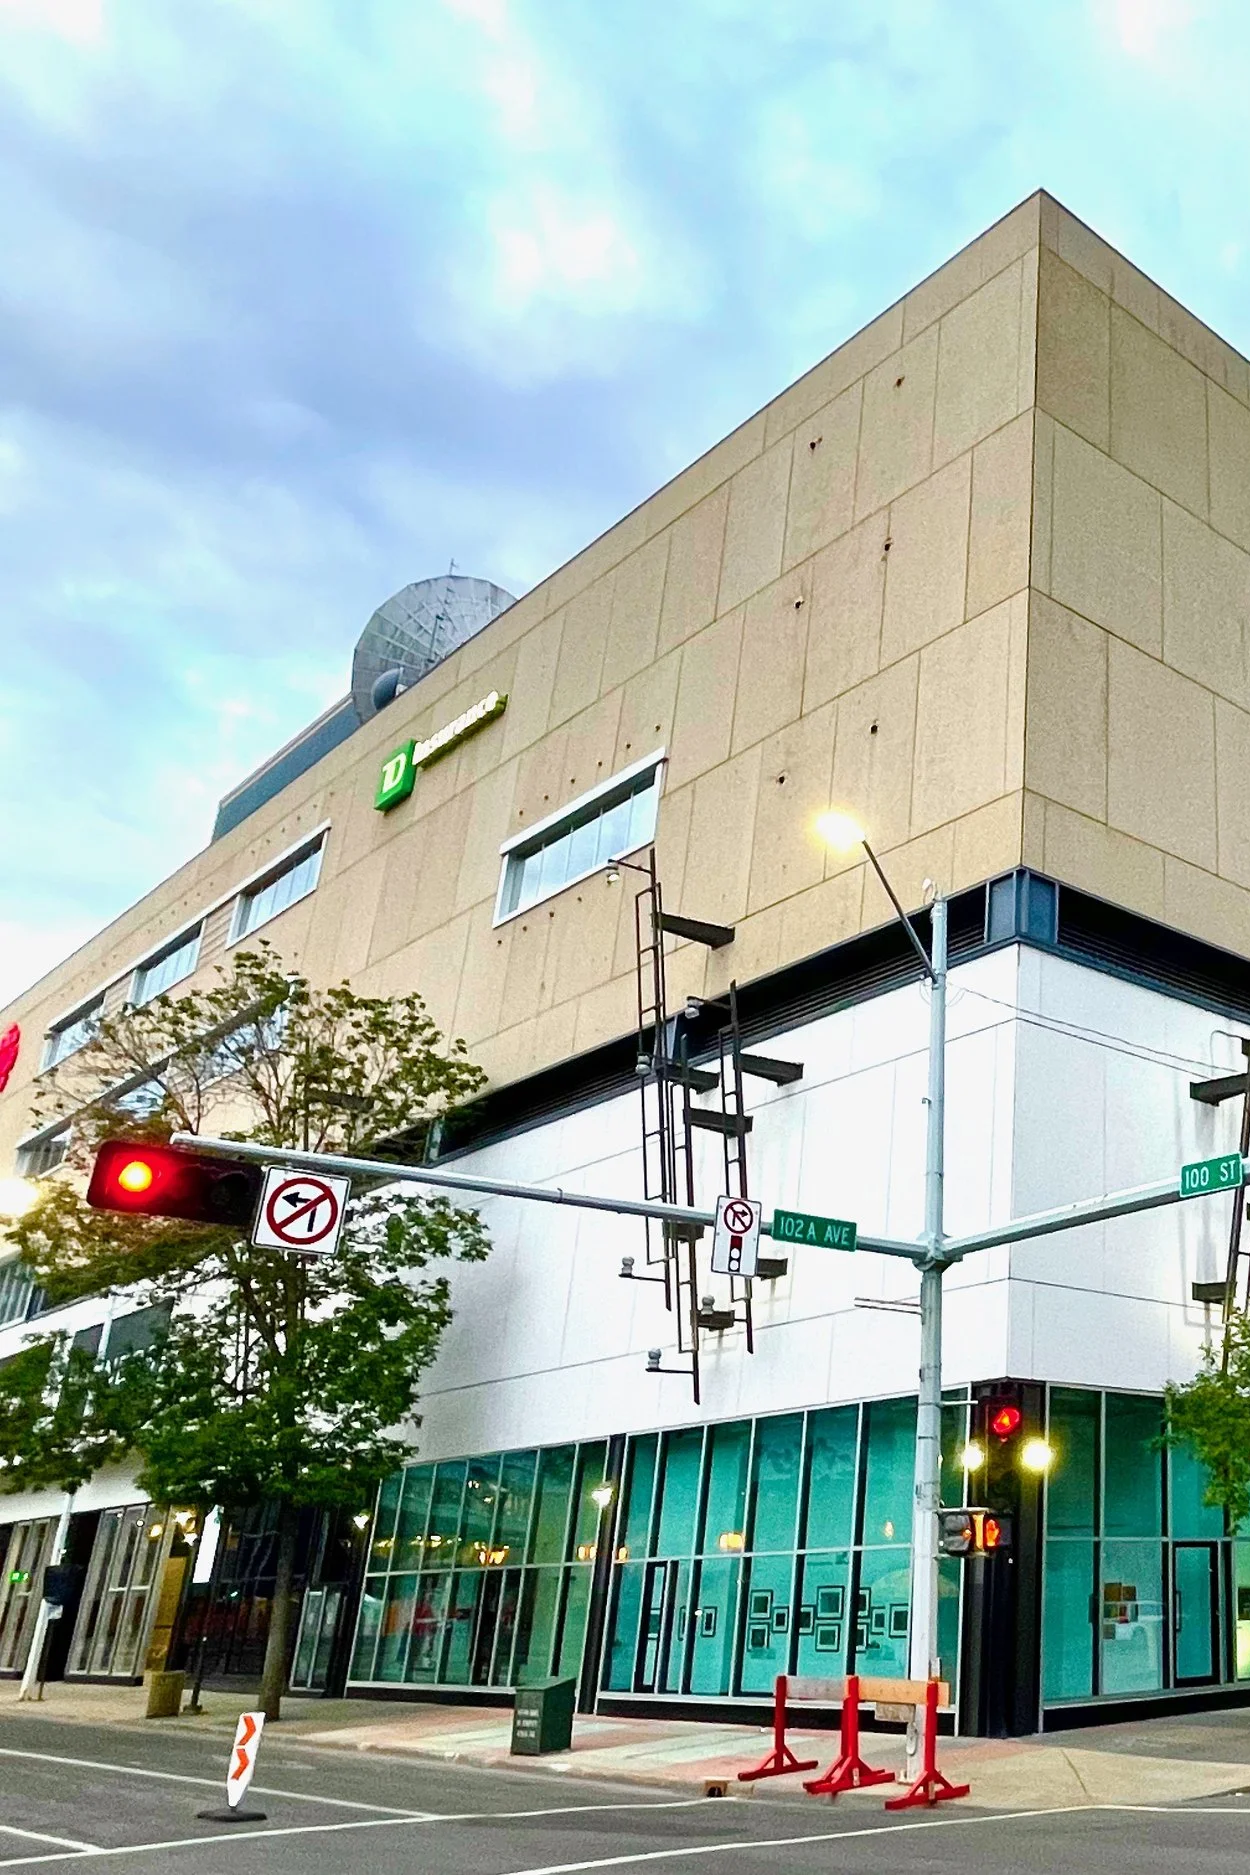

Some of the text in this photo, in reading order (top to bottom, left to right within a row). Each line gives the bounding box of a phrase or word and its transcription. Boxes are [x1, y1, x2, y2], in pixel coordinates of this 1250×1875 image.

[1185, 1160, 1237, 1189] 100 ST
[824, 1224, 850, 1246] AVE
